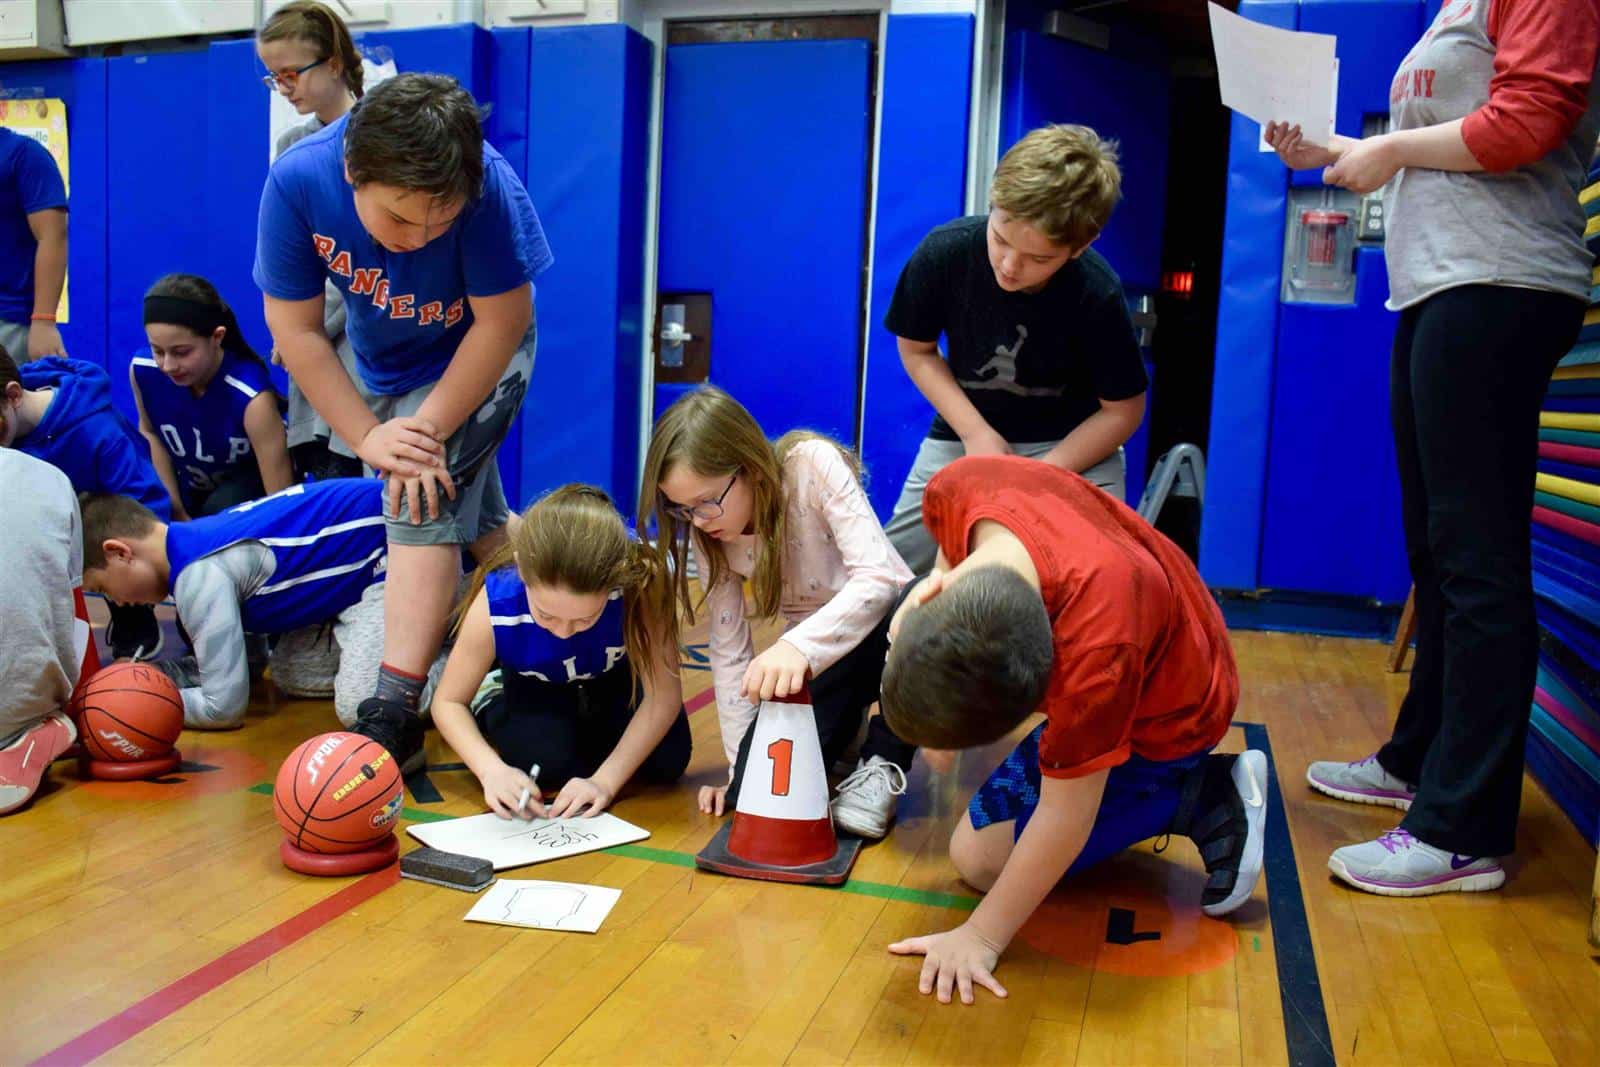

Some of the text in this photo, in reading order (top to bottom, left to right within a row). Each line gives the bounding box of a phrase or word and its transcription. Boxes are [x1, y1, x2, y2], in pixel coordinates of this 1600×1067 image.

[1413, 69, 1436, 98] NY
[312, 233, 464, 329] RANGERS
[767, 738, 794, 797] 1
